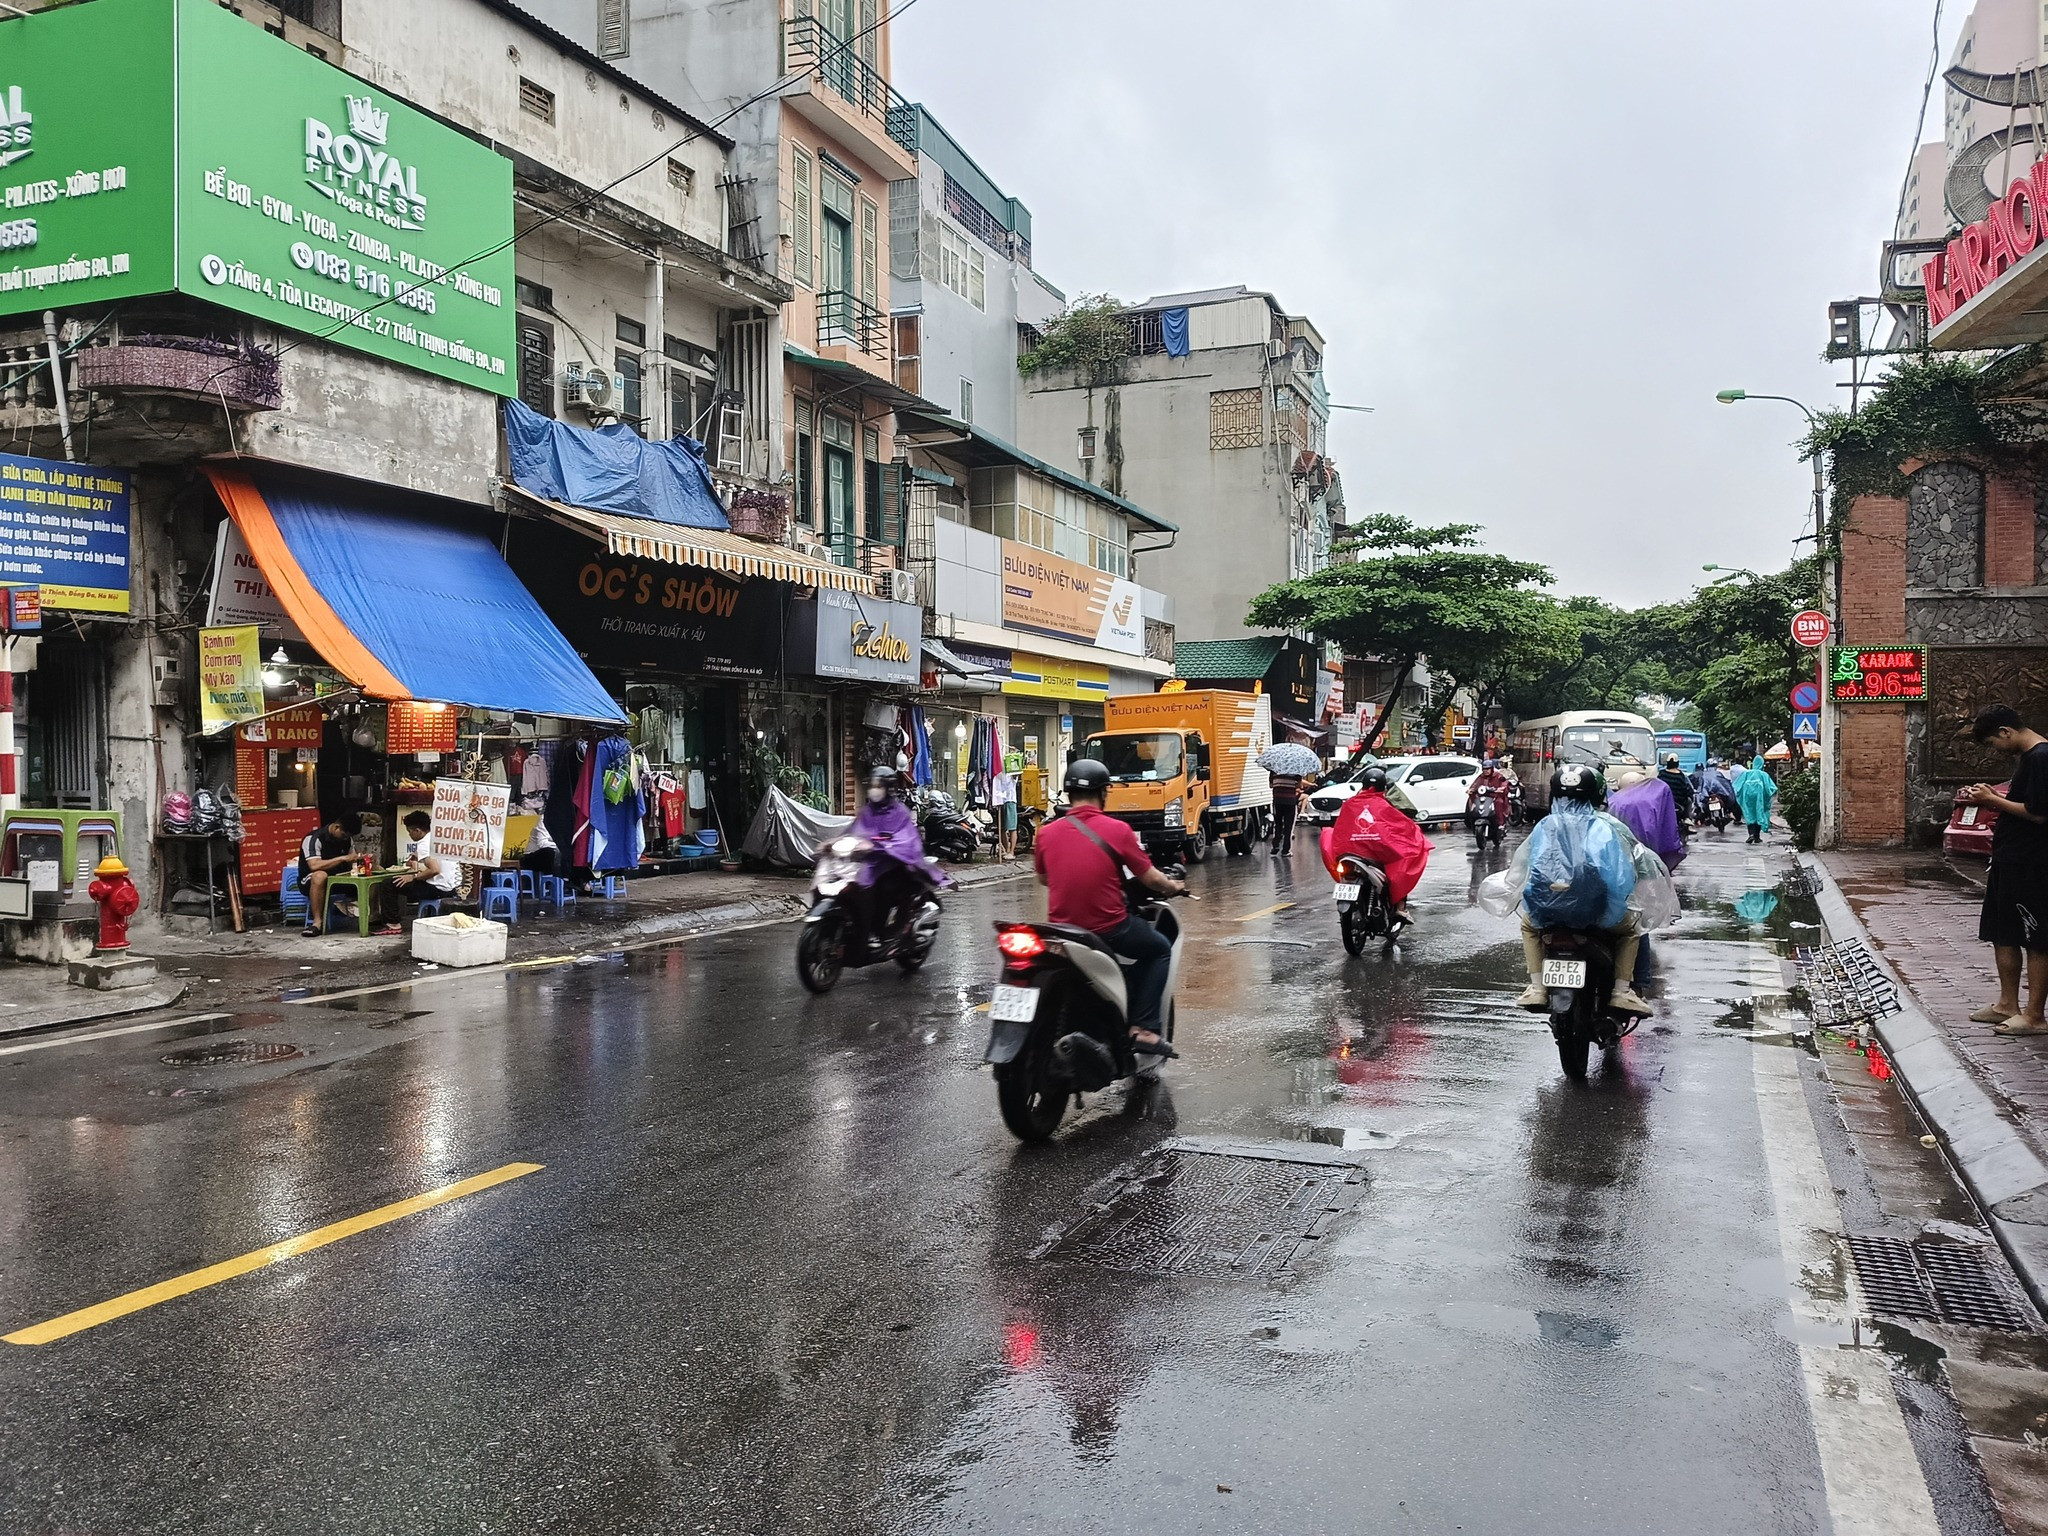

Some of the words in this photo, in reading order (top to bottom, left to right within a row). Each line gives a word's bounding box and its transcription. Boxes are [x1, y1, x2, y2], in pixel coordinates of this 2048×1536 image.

[305, 117, 427, 206] ROYAL
[5, 179, 58, 209] PILATES
[102, 165, 126, 191] HƠI
[305, 157, 427, 223] FITNESS
[334, 188, 363, 214] Yoga
[376, 208, 401, 230] Pool
[204, 166, 226, 198] BỂ
[226, 179, 252, 208] BƠI
[262, 194, 294, 225] GYM
[301, 210, 338, 243] YOGA
[347, 229, 392, 264] ZUMBA
[399, 251, 448, 286] PILATES
[453, 271, 483, 301] XÔNG
[483, 285, 502, 307] HƠI
[313, 249, 351, 284] 083
[354, 264, 391, 298] 516
[394, 280, 437, 316] 0555
[226, 258, 261, 293] TẦNG
[375, 316, 391, 337] 27
[392, 321, 417, 347] THÁI
[418, 330, 448, 358] THỊNH
[2, 463, 21, 481] SỬA
[26, 488, 46, 506] ĐIỆN
[47, 490, 66, 506] DÂN
[67, 494, 91, 511] DỤNG
[92, 498, 113, 512] 24/7
[1071, 577, 1090, 595] NAM
[661, 577, 740, 618] SHOW
[624, 620, 656, 636] TRANG
[657, 622, 681, 638] XUẤT
[1797, 619, 1825, 631] BNI
[203, 634, 223, 649] Bánh
[204, 654, 222, 668] Cơm
[224, 654, 242, 666] rang
[1838, 650, 1858, 674] 5
[1043, 675, 1075, 687] POSTMART
[1833, 672, 1863, 681] SAO
[1865, 672, 1902, 697] 96
[1185, 703, 1208, 711] NAM
[276, 728, 319, 740] RANG
[436, 784, 461, 803] SỬA
[492, 796, 505, 809] ga
[435, 805, 466, 823] CHỮA
[489, 812, 504, 826] số
[434, 825, 465, 841] BƠM
[468, 828, 485, 843] VÁ
[433, 842, 465, 857] THAY
[1544, 973, 1582, 986] 060.88
